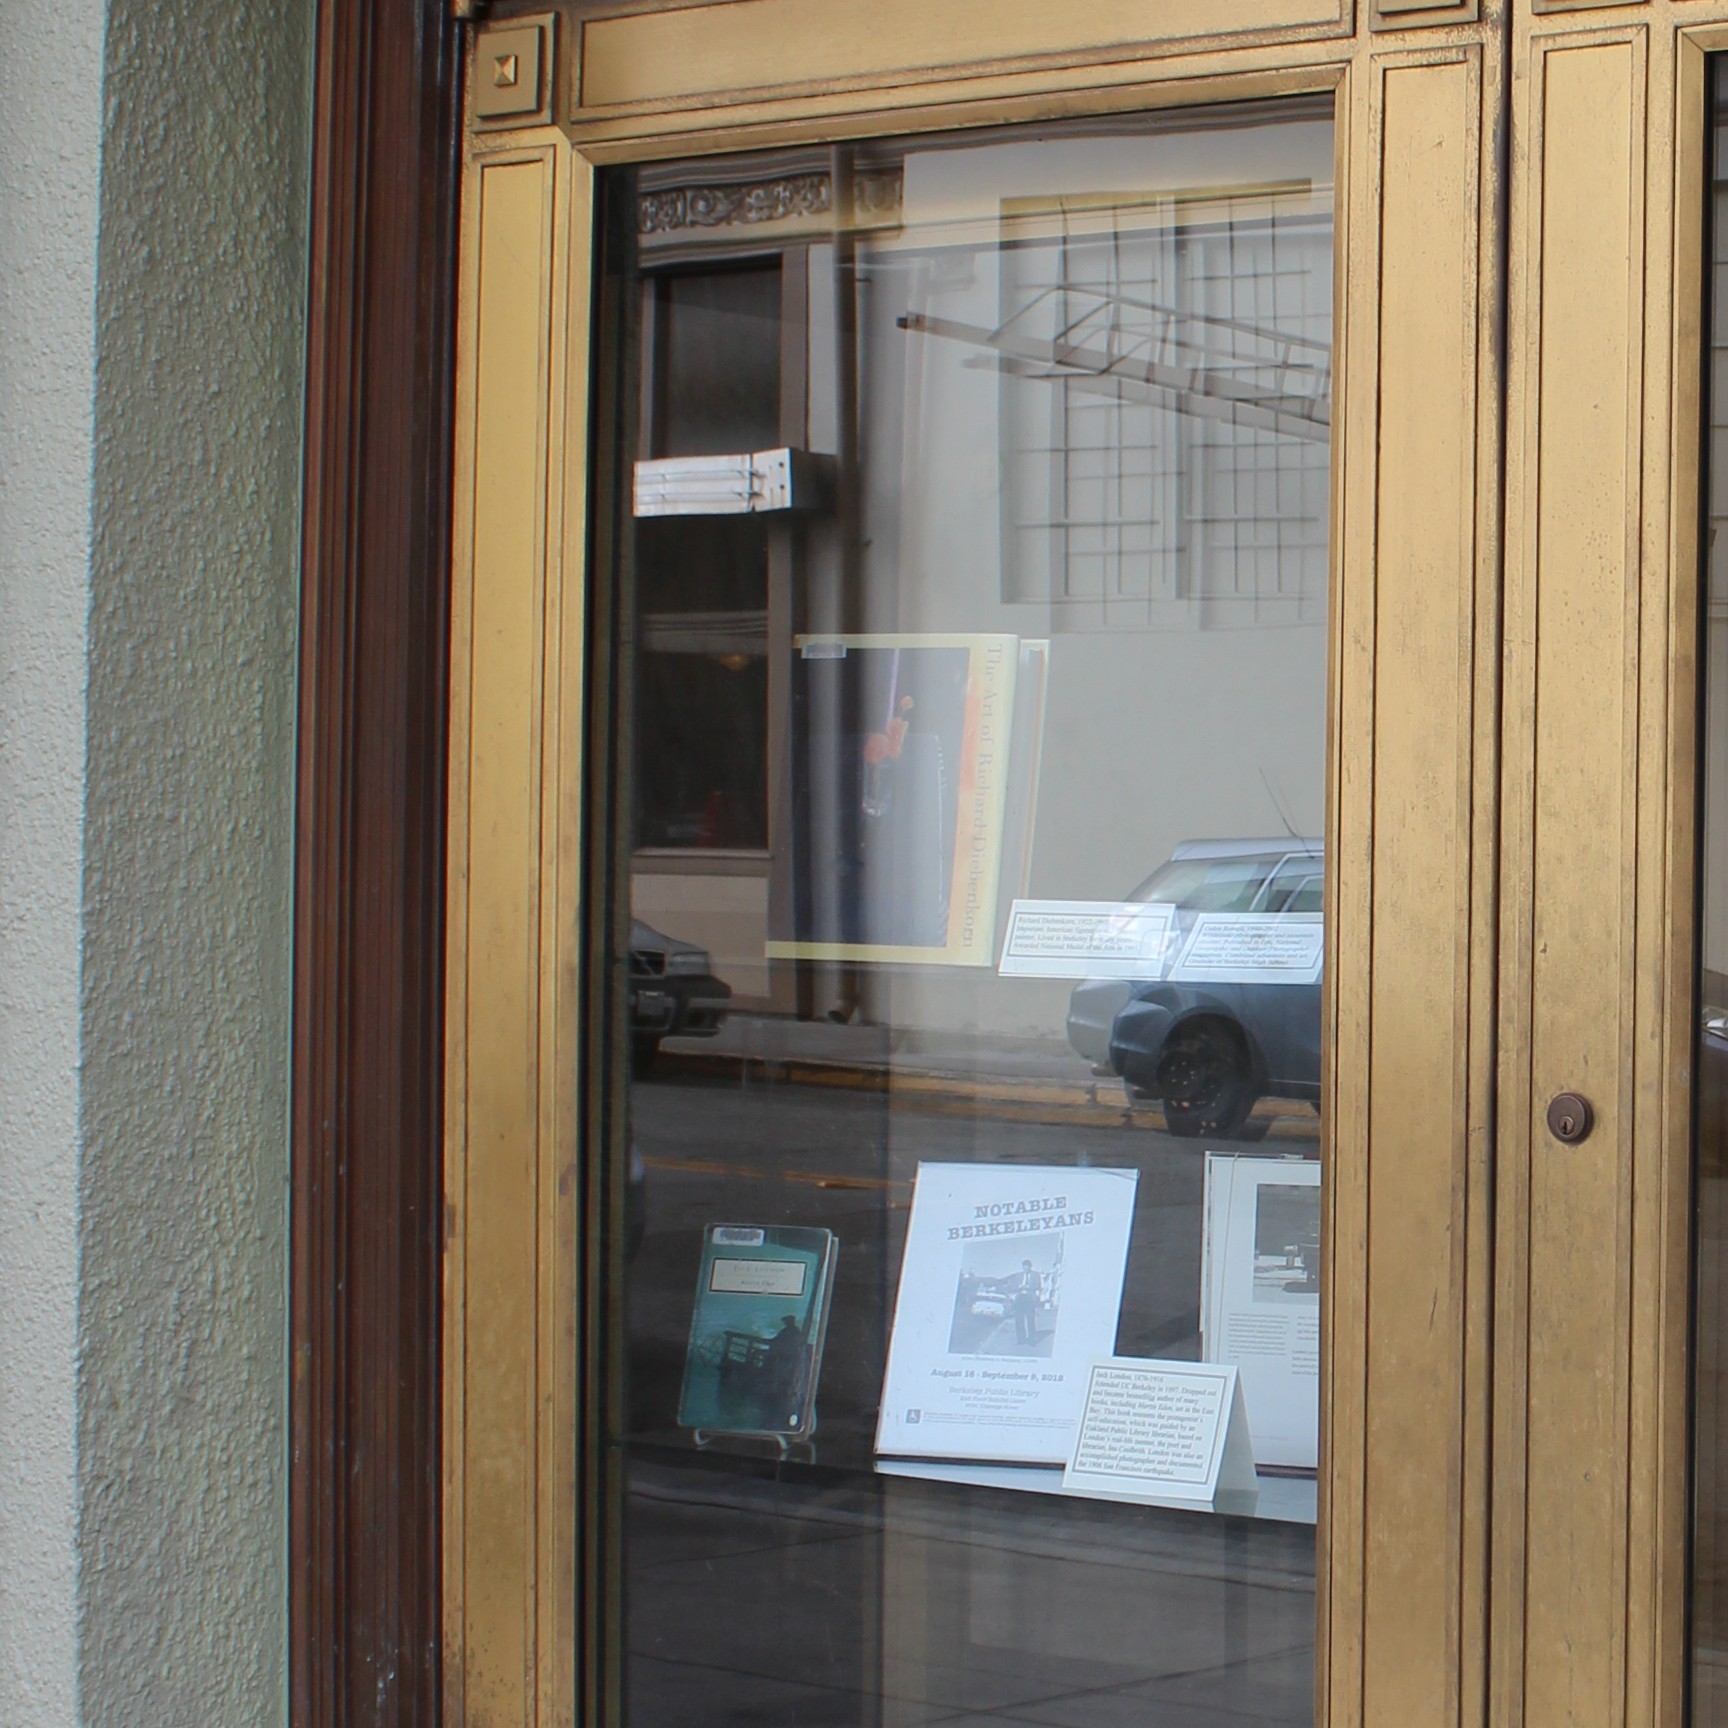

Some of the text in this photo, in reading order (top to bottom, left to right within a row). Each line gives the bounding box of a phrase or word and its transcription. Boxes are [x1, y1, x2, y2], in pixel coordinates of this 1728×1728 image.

[963, 643, 1002, 948] The Art of Richard Diebenkorn
[974, 1196, 1067, 1219] NOTABLE
[947, 1210, 1095, 1241] BERKELEYANS
[930, 1368, 962, 1378] August
[982, 1370, 1029, 1380] September
[949, 1386, 983, 1395] Berkeley
[1010, 1389, 1040, 1398] Library
